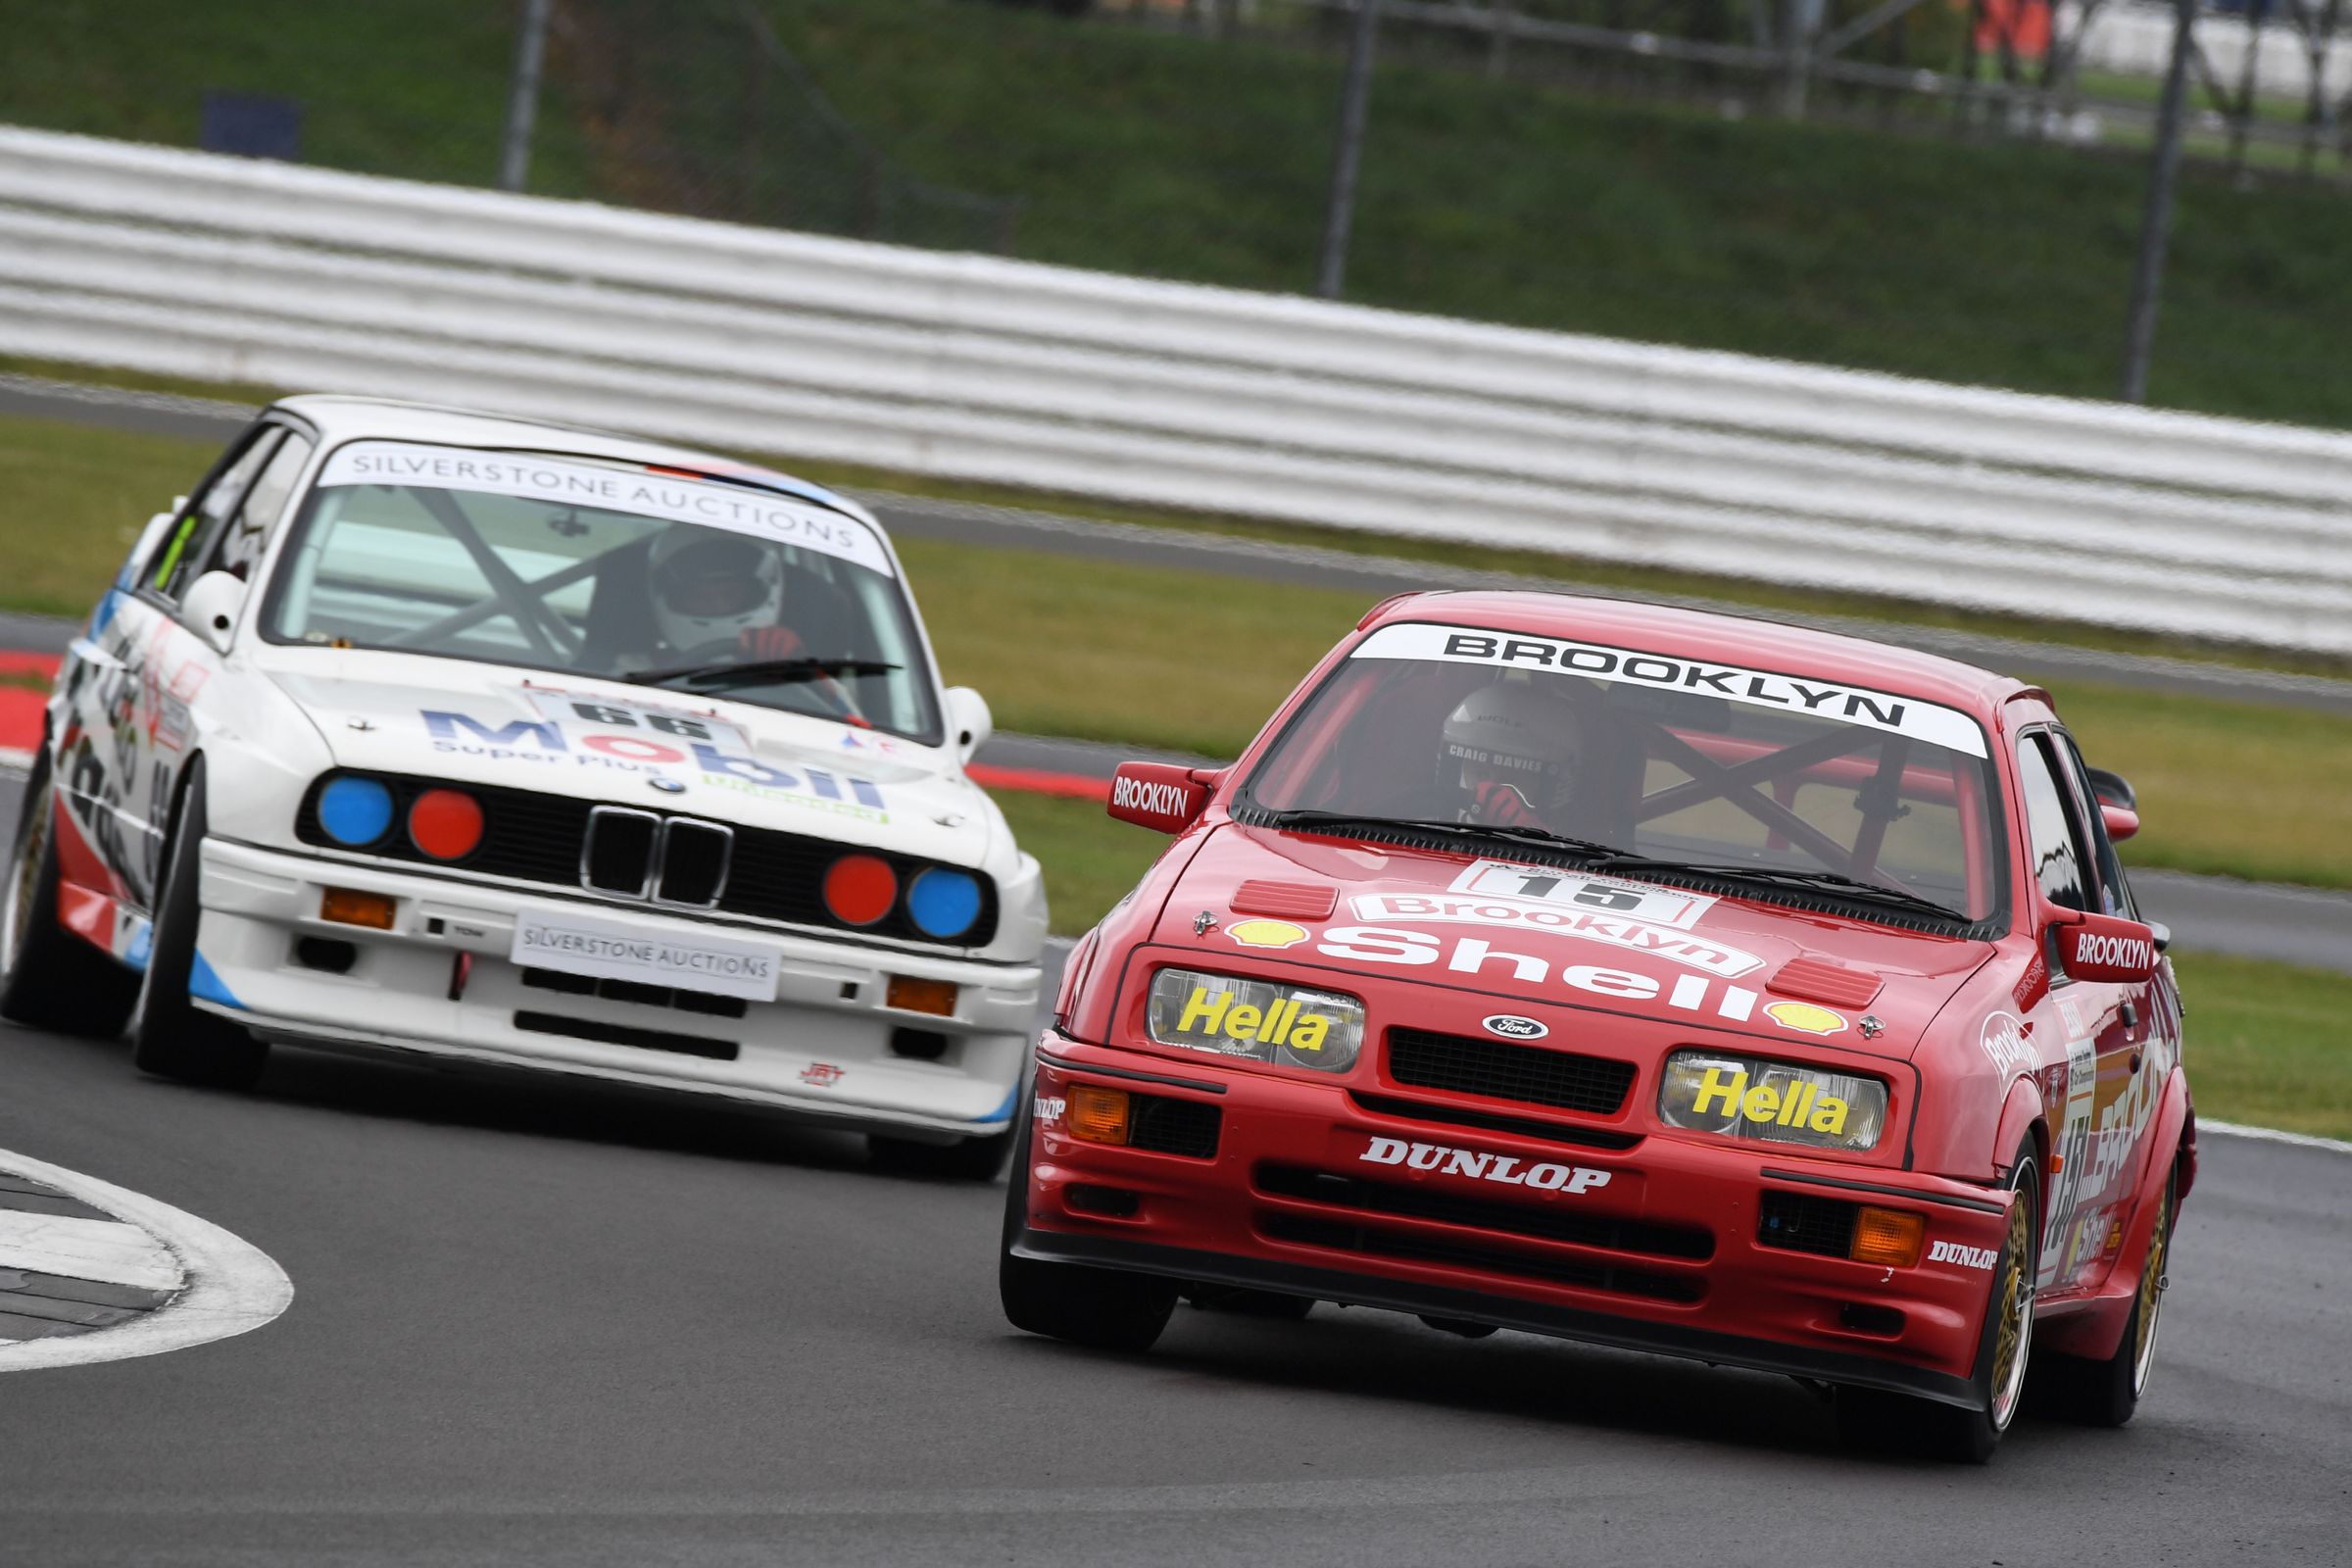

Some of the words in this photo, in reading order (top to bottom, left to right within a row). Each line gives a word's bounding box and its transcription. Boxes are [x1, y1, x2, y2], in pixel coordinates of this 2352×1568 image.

[353, 455, 619, 498] SILVERSTONE
[631, 487, 854, 549] AUCTIONS
[1444, 633, 1906, 728] BROOKLYN
[420, 710, 887, 809] Mobil
[432, 741, 558, 764] Super
[576, 754, 663, 777] Plus
[1449, 744, 1488, 762] CRAIG
[1493, 754, 1543, 771] DAVIES
[1113, 776, 1189, 817] BROOKLYN
[1518, 875, 1646, 911] 15
[524, 927, 654, 960] SILVERSTONE
[657, 948, 768, 978] AUCTIONS
[1379, 897, 1735, 968] Brooklyn
[2076, 933, 2151, 970] BROOKLYN
[1317, 925, 1759, 1022] Shell
[1177, 987, 1329, 1052] Hella
[1497, 1019, 1533, 1034] Ford
[1034, 1097, 1066, 1120] NLOP
[1691, 1067, 1849, 1136] Hella
[1359, 1136, 1612, 1195] DUNLOP
[1928, 1240, 1997, 1271] DUNLOP
